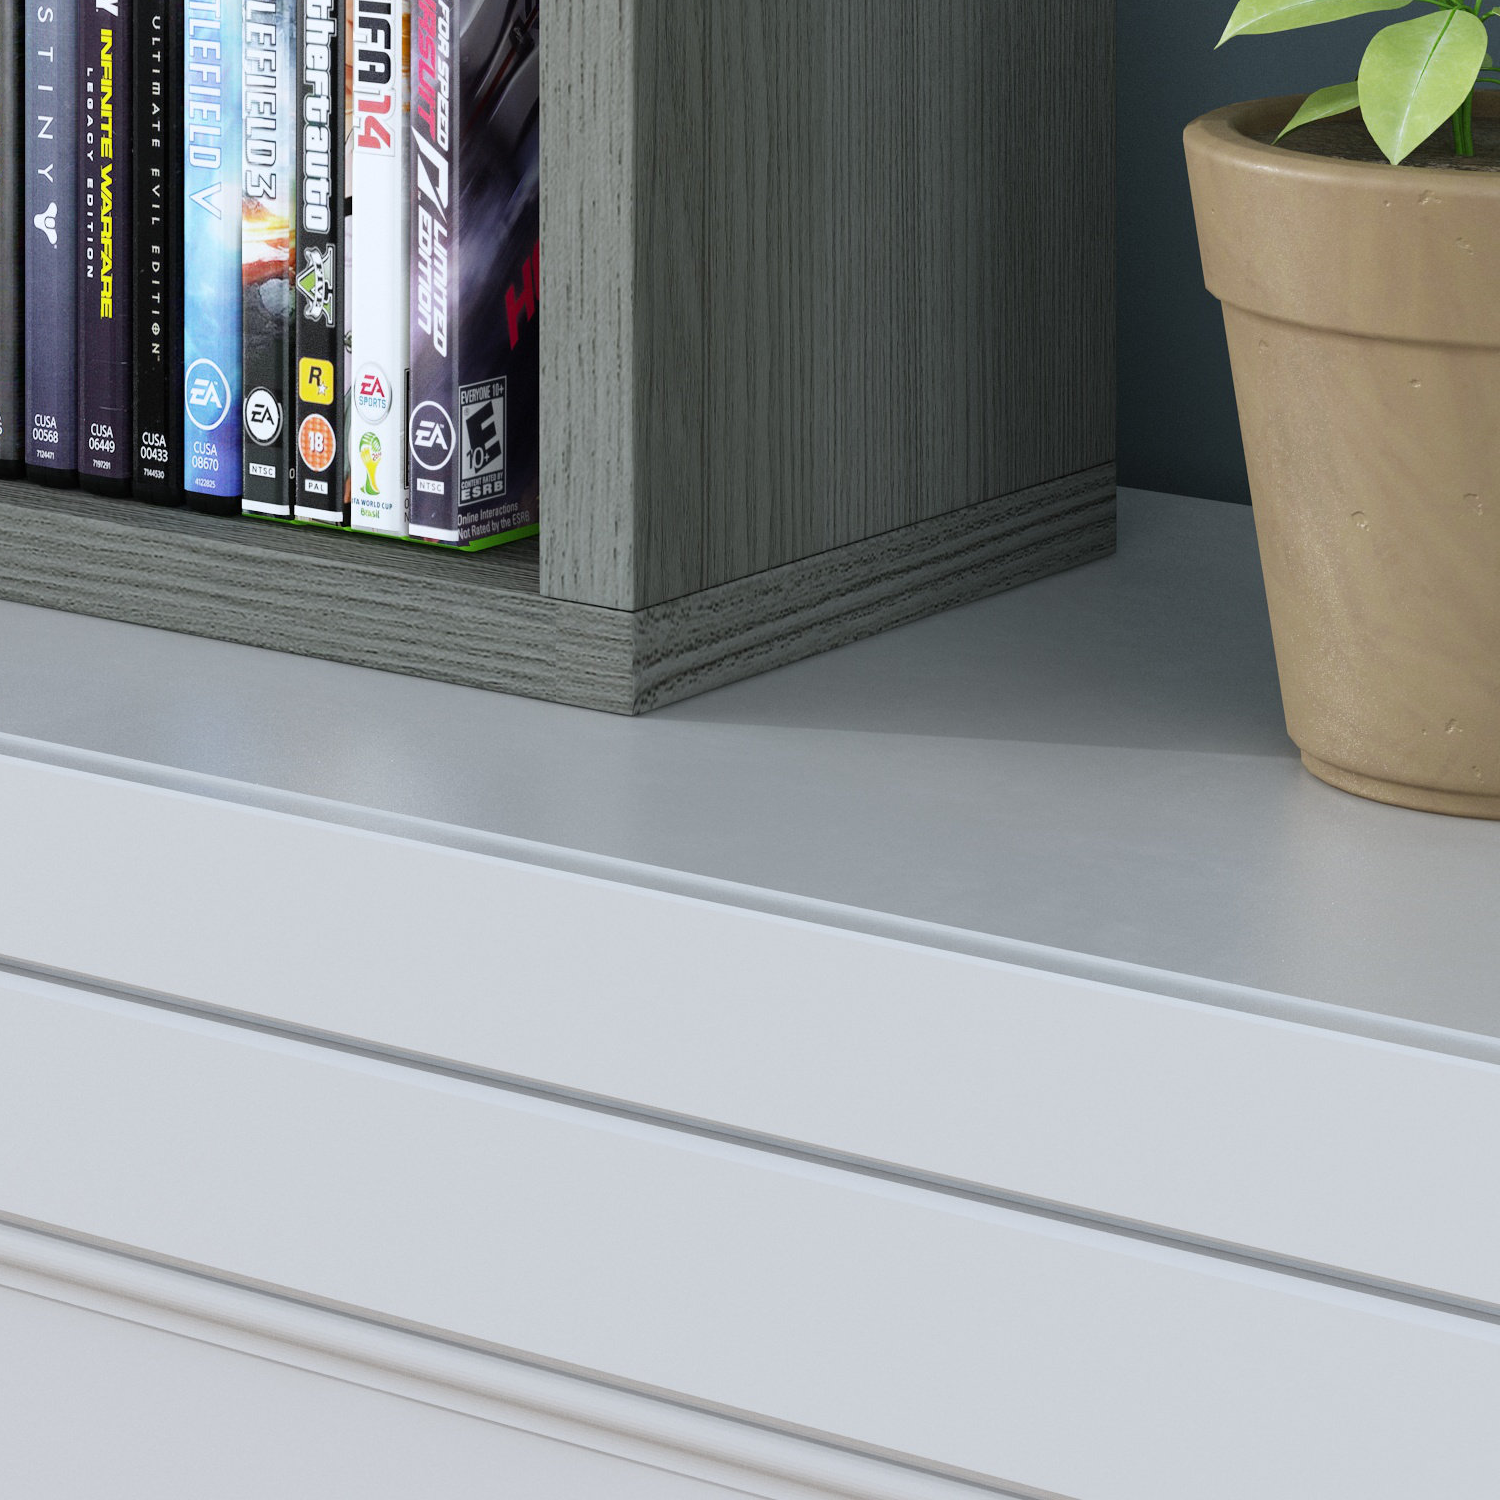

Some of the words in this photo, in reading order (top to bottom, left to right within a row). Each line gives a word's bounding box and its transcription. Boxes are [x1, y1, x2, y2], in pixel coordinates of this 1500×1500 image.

[151, 15, 161, 148] ULTIMATE
[100, 28, 113, 160] INFINITE
[436, 54, 450, 152] SPEED
[86, 66, 94, 162] LEGACY
[358, 94, 392, 150] 14
[245, 169, 277, 200] 3
[304, 124, 332, 232] auto
[151, 167, 161, 226] EVIL
[189, 182, 222, 220] V
[86, 177, 94, 279] EDITION
[100, 165, 113, 320] WARFARE
[417, 204, 432, 336] EDITION
[315, 263, 325, 308] FIVE
[433, 219, 448, 358] LIMITED
[151, 245, 161, 354] EDITION
[190, 377, 222, 409] EA
[359, 374, 386, 398] EA
[460, 385, 491, 405] EVERYONE
[492, 382, 504, 398] 10+
[358, 395, 387, 409] SPORTS
[34, 413, 57, 429] CUSA
[250, 403, 275, 426] EA
[32, 428, 59, 444] 00568
[90, 423, 113, 439] CUSA
[142, 431, 166, 447] CUSA
[308, 431, 325, 453] 18
[415, 420, 448, 450] EA
[465, 400, 502, 474] E
[88, 437, 116, 453] 06449
[140, 445, 168, 463] 00433
[192, 440, 218, 457] CUSA
[191, 455, 219, 472] 08670
[466, 446, 490, 470] 10+
[251, 465, 274, 477] NTSC
[307, 481, 325, 492] PAL
[419, 481, 442, 492] NTSC
[460, 477, 482, 490] CONTENT
[460, 480, 504, 501] ESRB
[360, 498, 381, 509] WORLD
[360, 509, 380, 519] Brasil
[457, 509, 479, 527] Online
[480, 501, 519, 520] Interactions
[471, 521, 491, 538] Rated
[512, 510, 530, 526] ESRB
